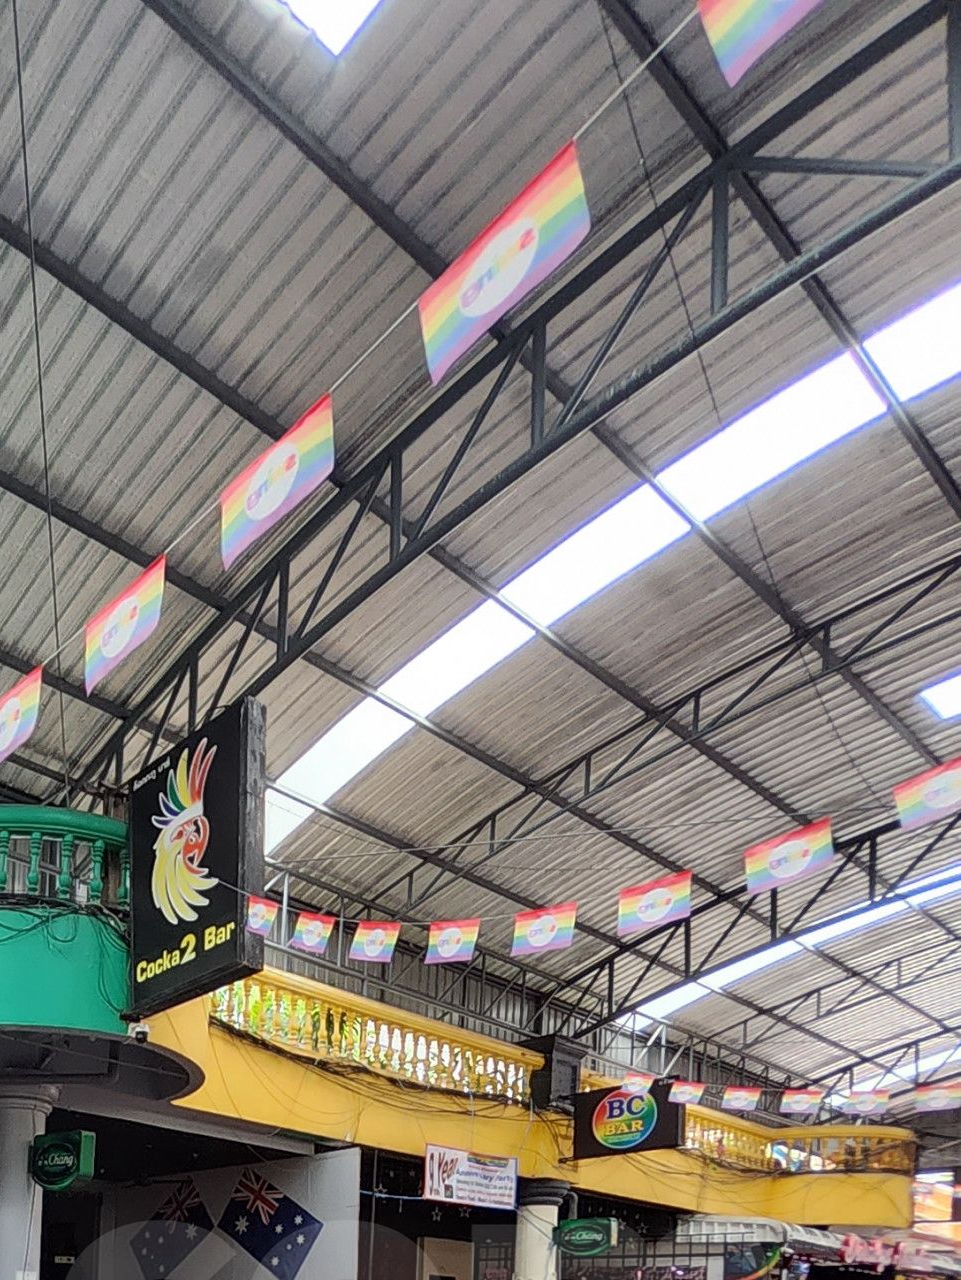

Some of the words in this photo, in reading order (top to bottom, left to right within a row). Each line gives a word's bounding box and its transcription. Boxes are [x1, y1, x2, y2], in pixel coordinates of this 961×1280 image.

[136, 932, 197, 983] Cocka2
[204, 921, 236, 951] Bar
[605, 1093, 647, 1120] BC
[604, 1118, 645, 1136] BAR
[48, 1152, 74, 1168] Chang
[428, 1152, 435, 1196] 9
[437, 1151, 459, 1188] Year
[575, 1230, 604, 1242] Chang
